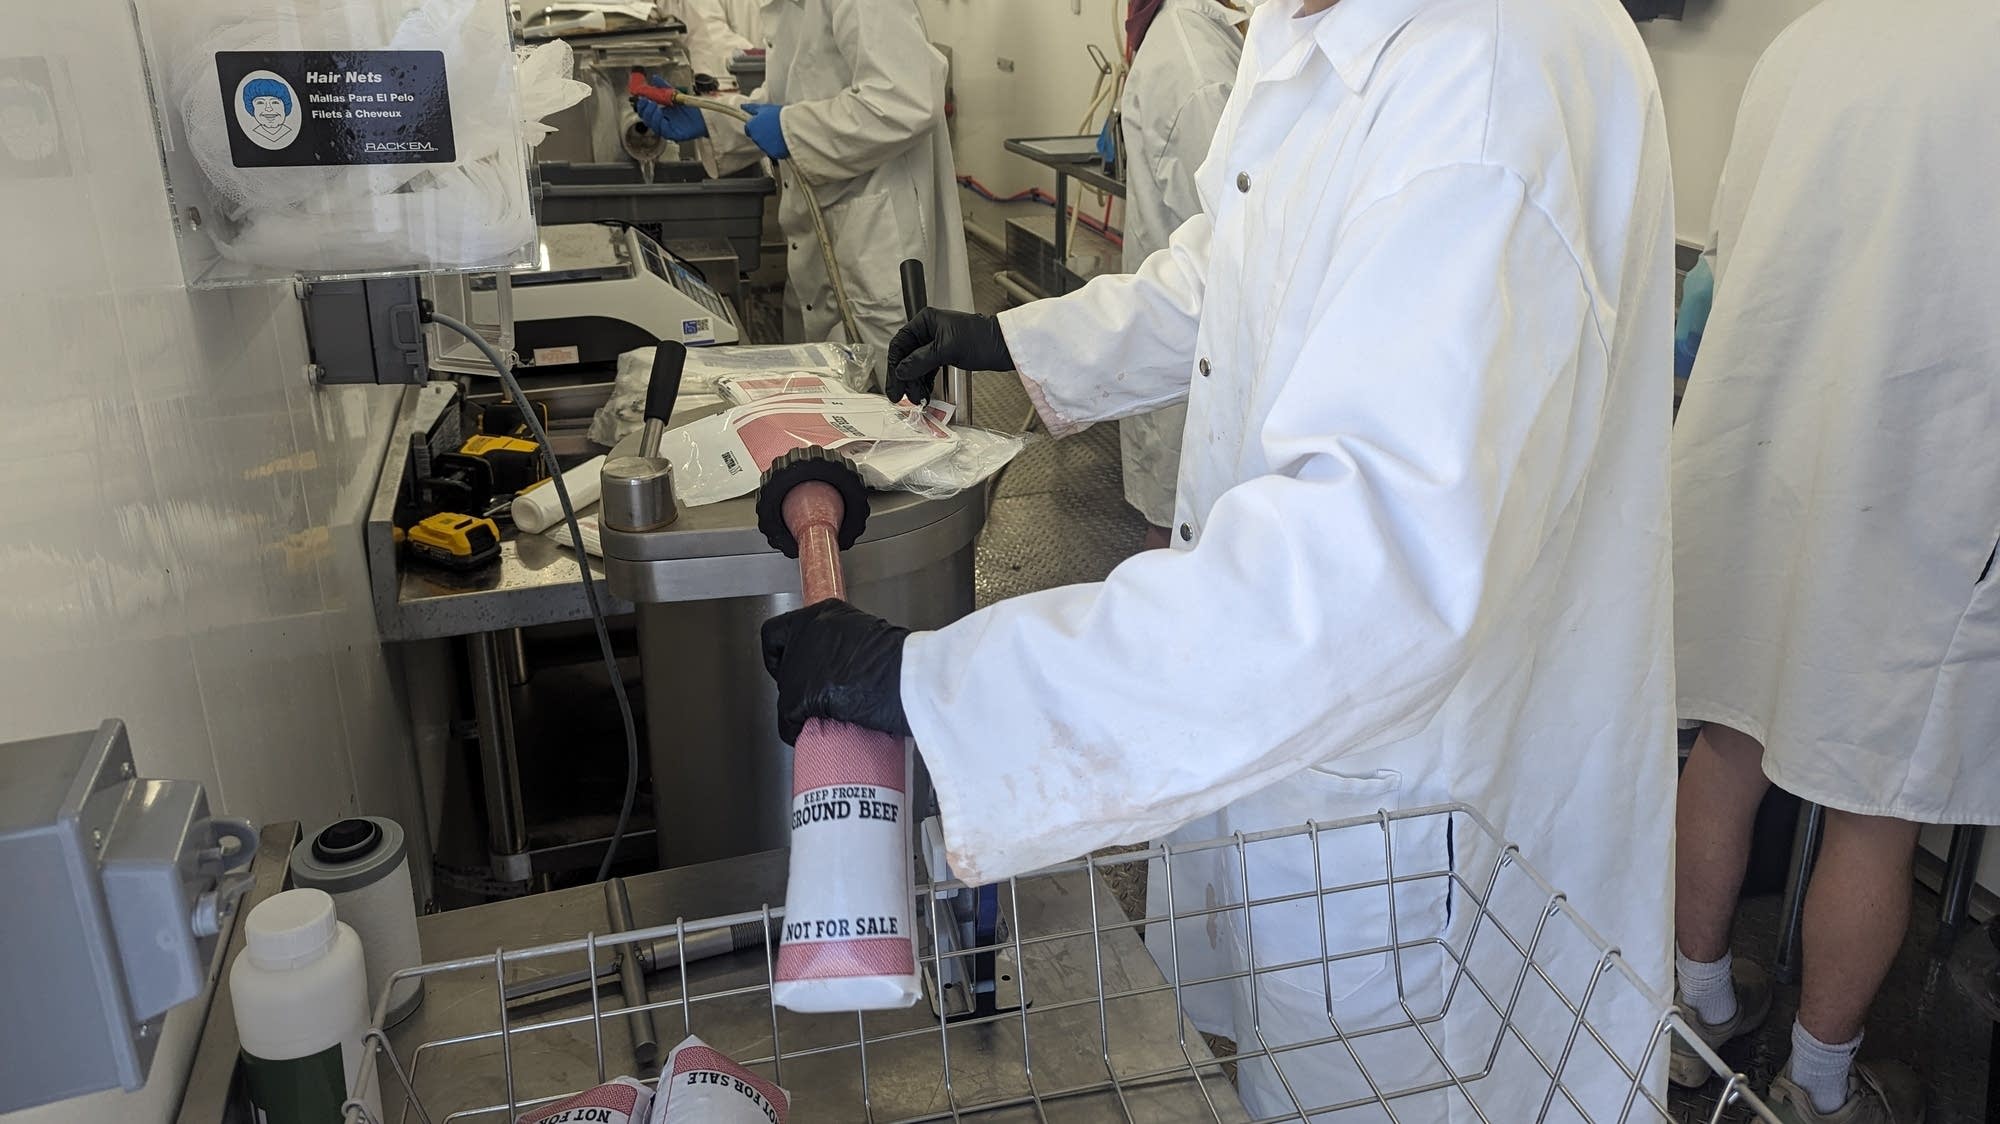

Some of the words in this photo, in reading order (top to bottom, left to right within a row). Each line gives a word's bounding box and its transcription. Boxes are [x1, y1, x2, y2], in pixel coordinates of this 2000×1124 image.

[306, 72, 341, 84] Hair
[345, 71, 383, 83] Nets
[309, 93, 346, 103] Mallas
[348, 93, 374, 102] Para
[376, 93, 389, 102] El
[390, 93, 414, 102] Pelo
[311, 109, 343, 119] Filets
[345, 109, 353, 118] à
[355, 109, 402, 118] Cheveux
[803, 789, 829, 805] KEEP
[831, 786, 876, 799] FROZEN
[858, 800, 899, 823] BEEF
[786, 921, 811, 941] NOT
[815, 919, 850, 938] FOR
[855, 917, 898, 936] SALE
[687, 1071, 730, 1086] SALE
[734, 1079, 761, 1106] FOR
[573, 1108, 612, 1124] NOT
